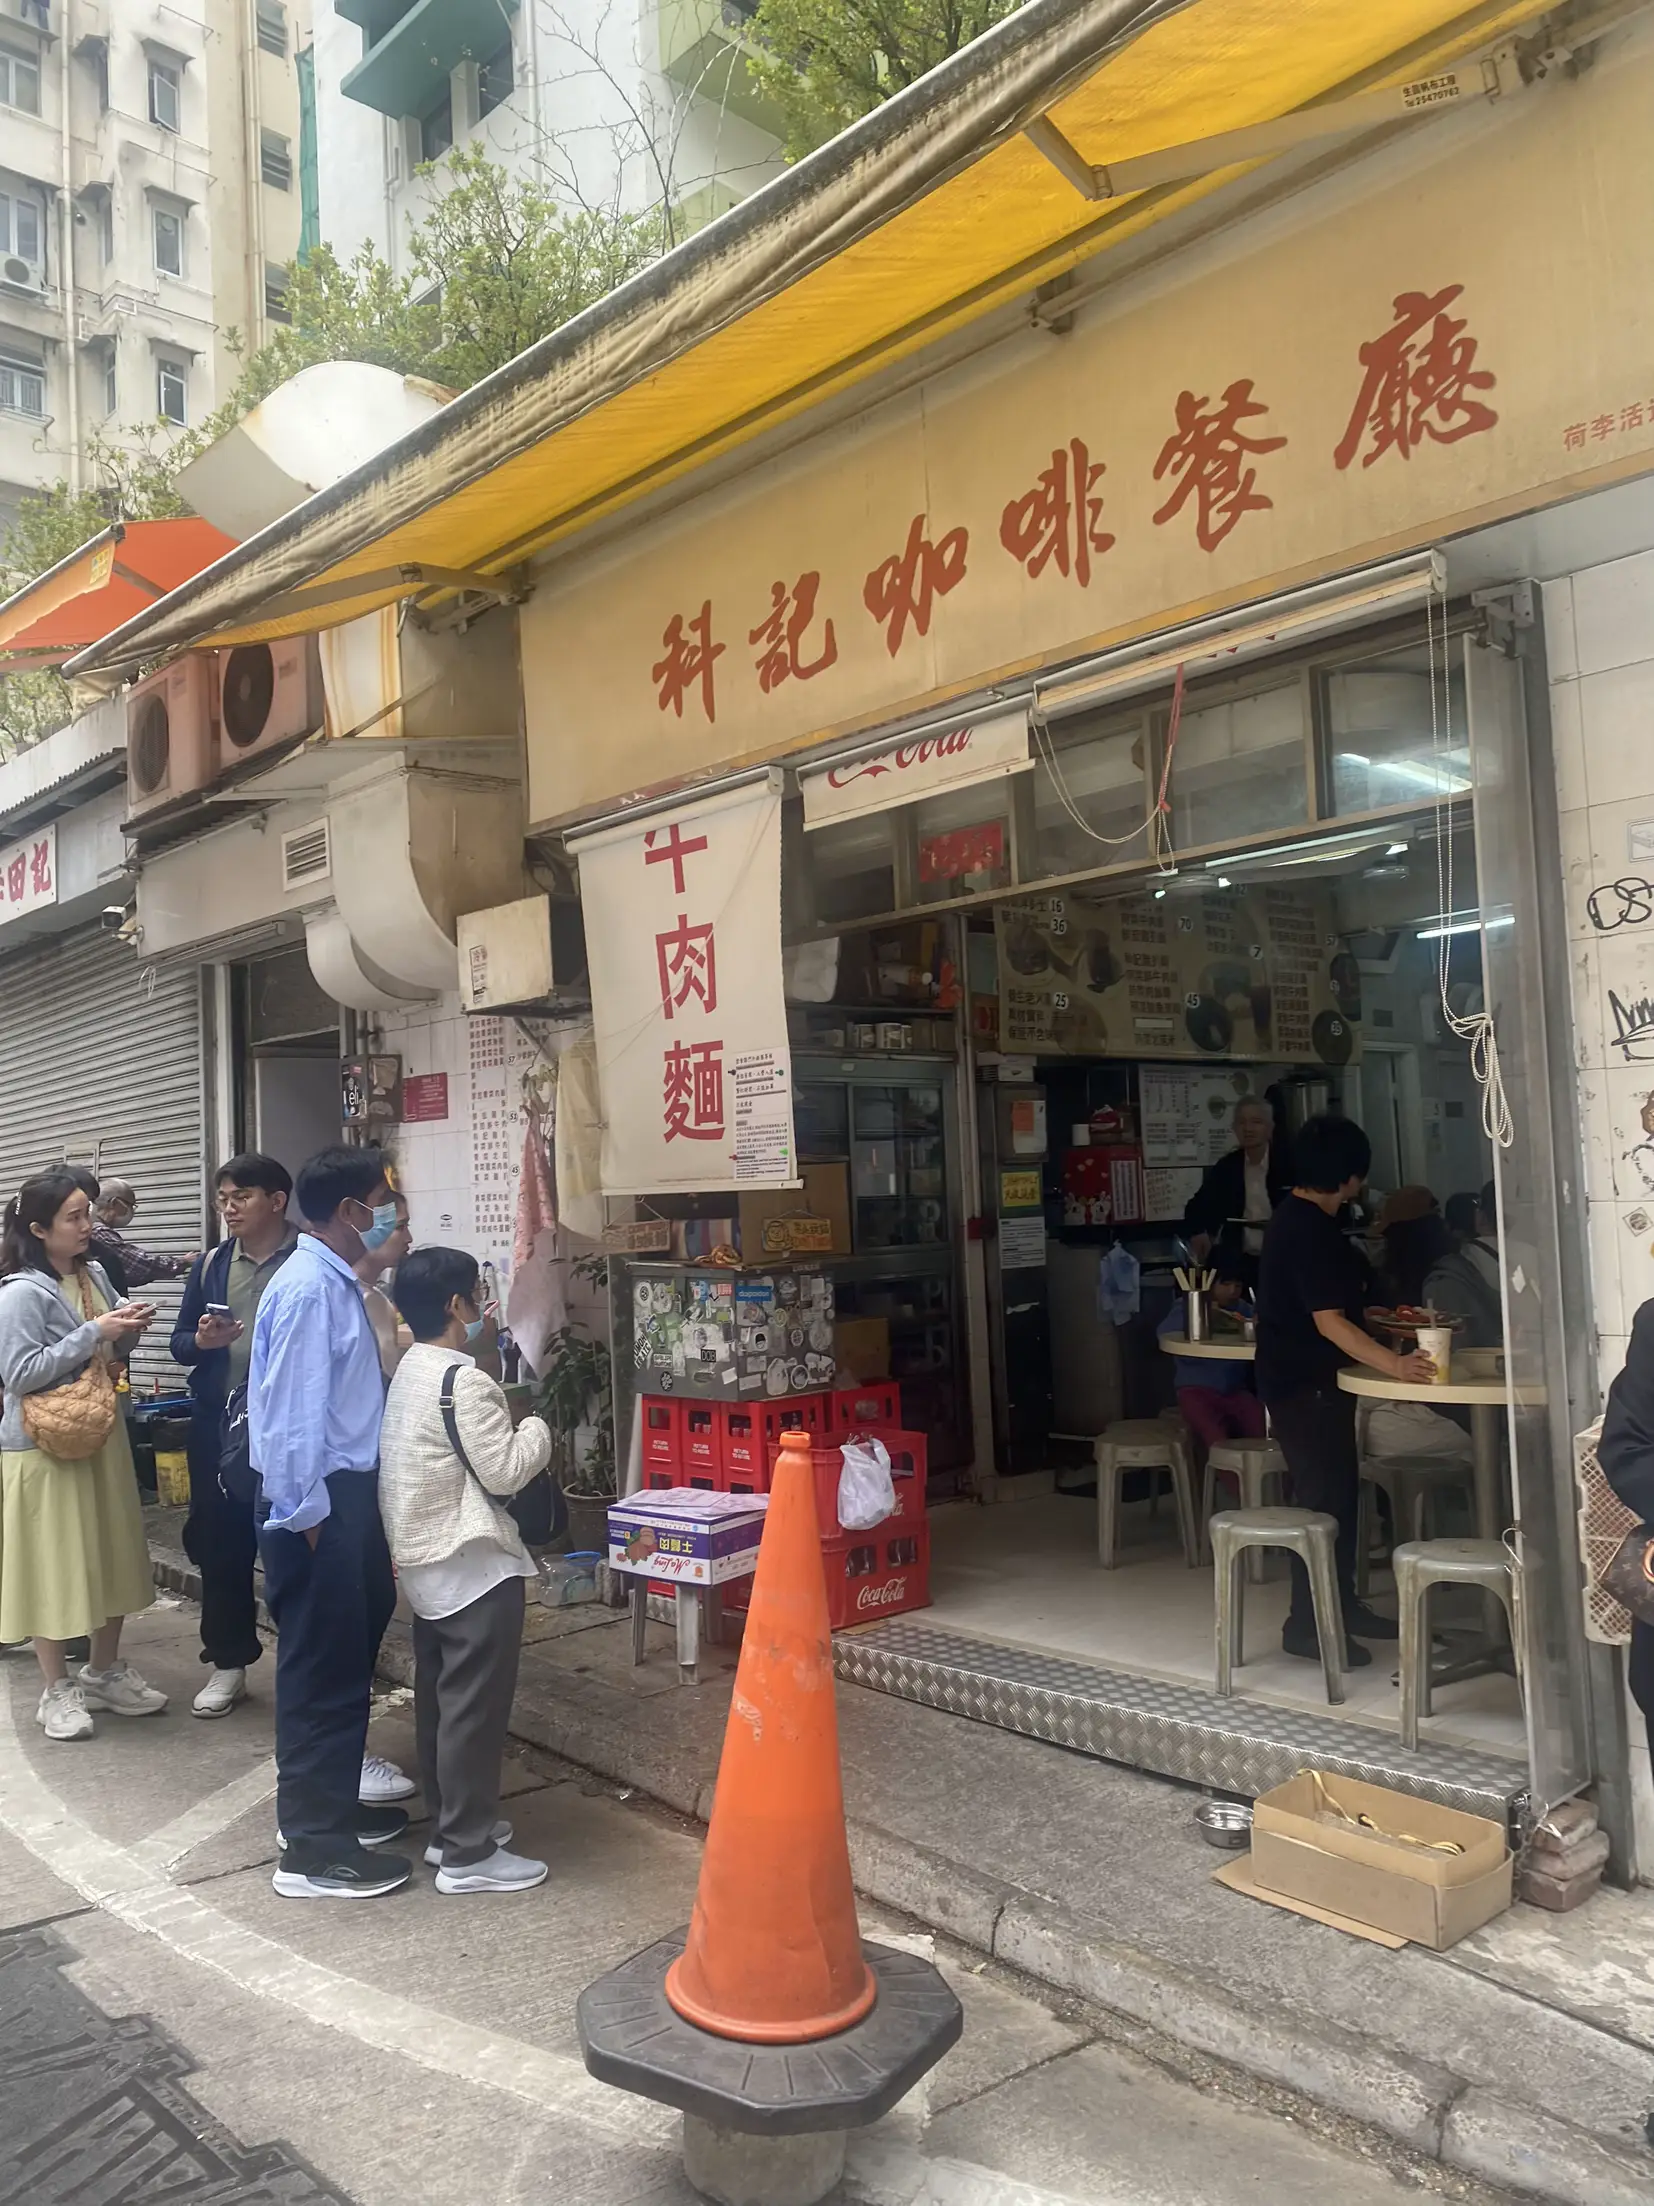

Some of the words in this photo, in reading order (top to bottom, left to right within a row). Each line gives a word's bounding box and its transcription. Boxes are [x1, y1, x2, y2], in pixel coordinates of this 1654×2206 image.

[652, 284, 1497, 722] 科記咖啡餐廳
[0, 839, 52, 902] 田記
[1051, 899, 1063, 913] 16
[1052, 918, 1065, 933] 36
[1179, 917, 1192, 930] 70
[1253, 946, 1263, 958] 7
[644, 822, 726, 1144] 牛肉麵
[1055, 993, 1067, 1007] 25
[1187, 993, 1199, 1007] 45
[508, 1055, 516, 1064] 57
[659, 1537, 693, 1554] 午餐肉
[857, 1576, 907, 1610] Coca-Cola
